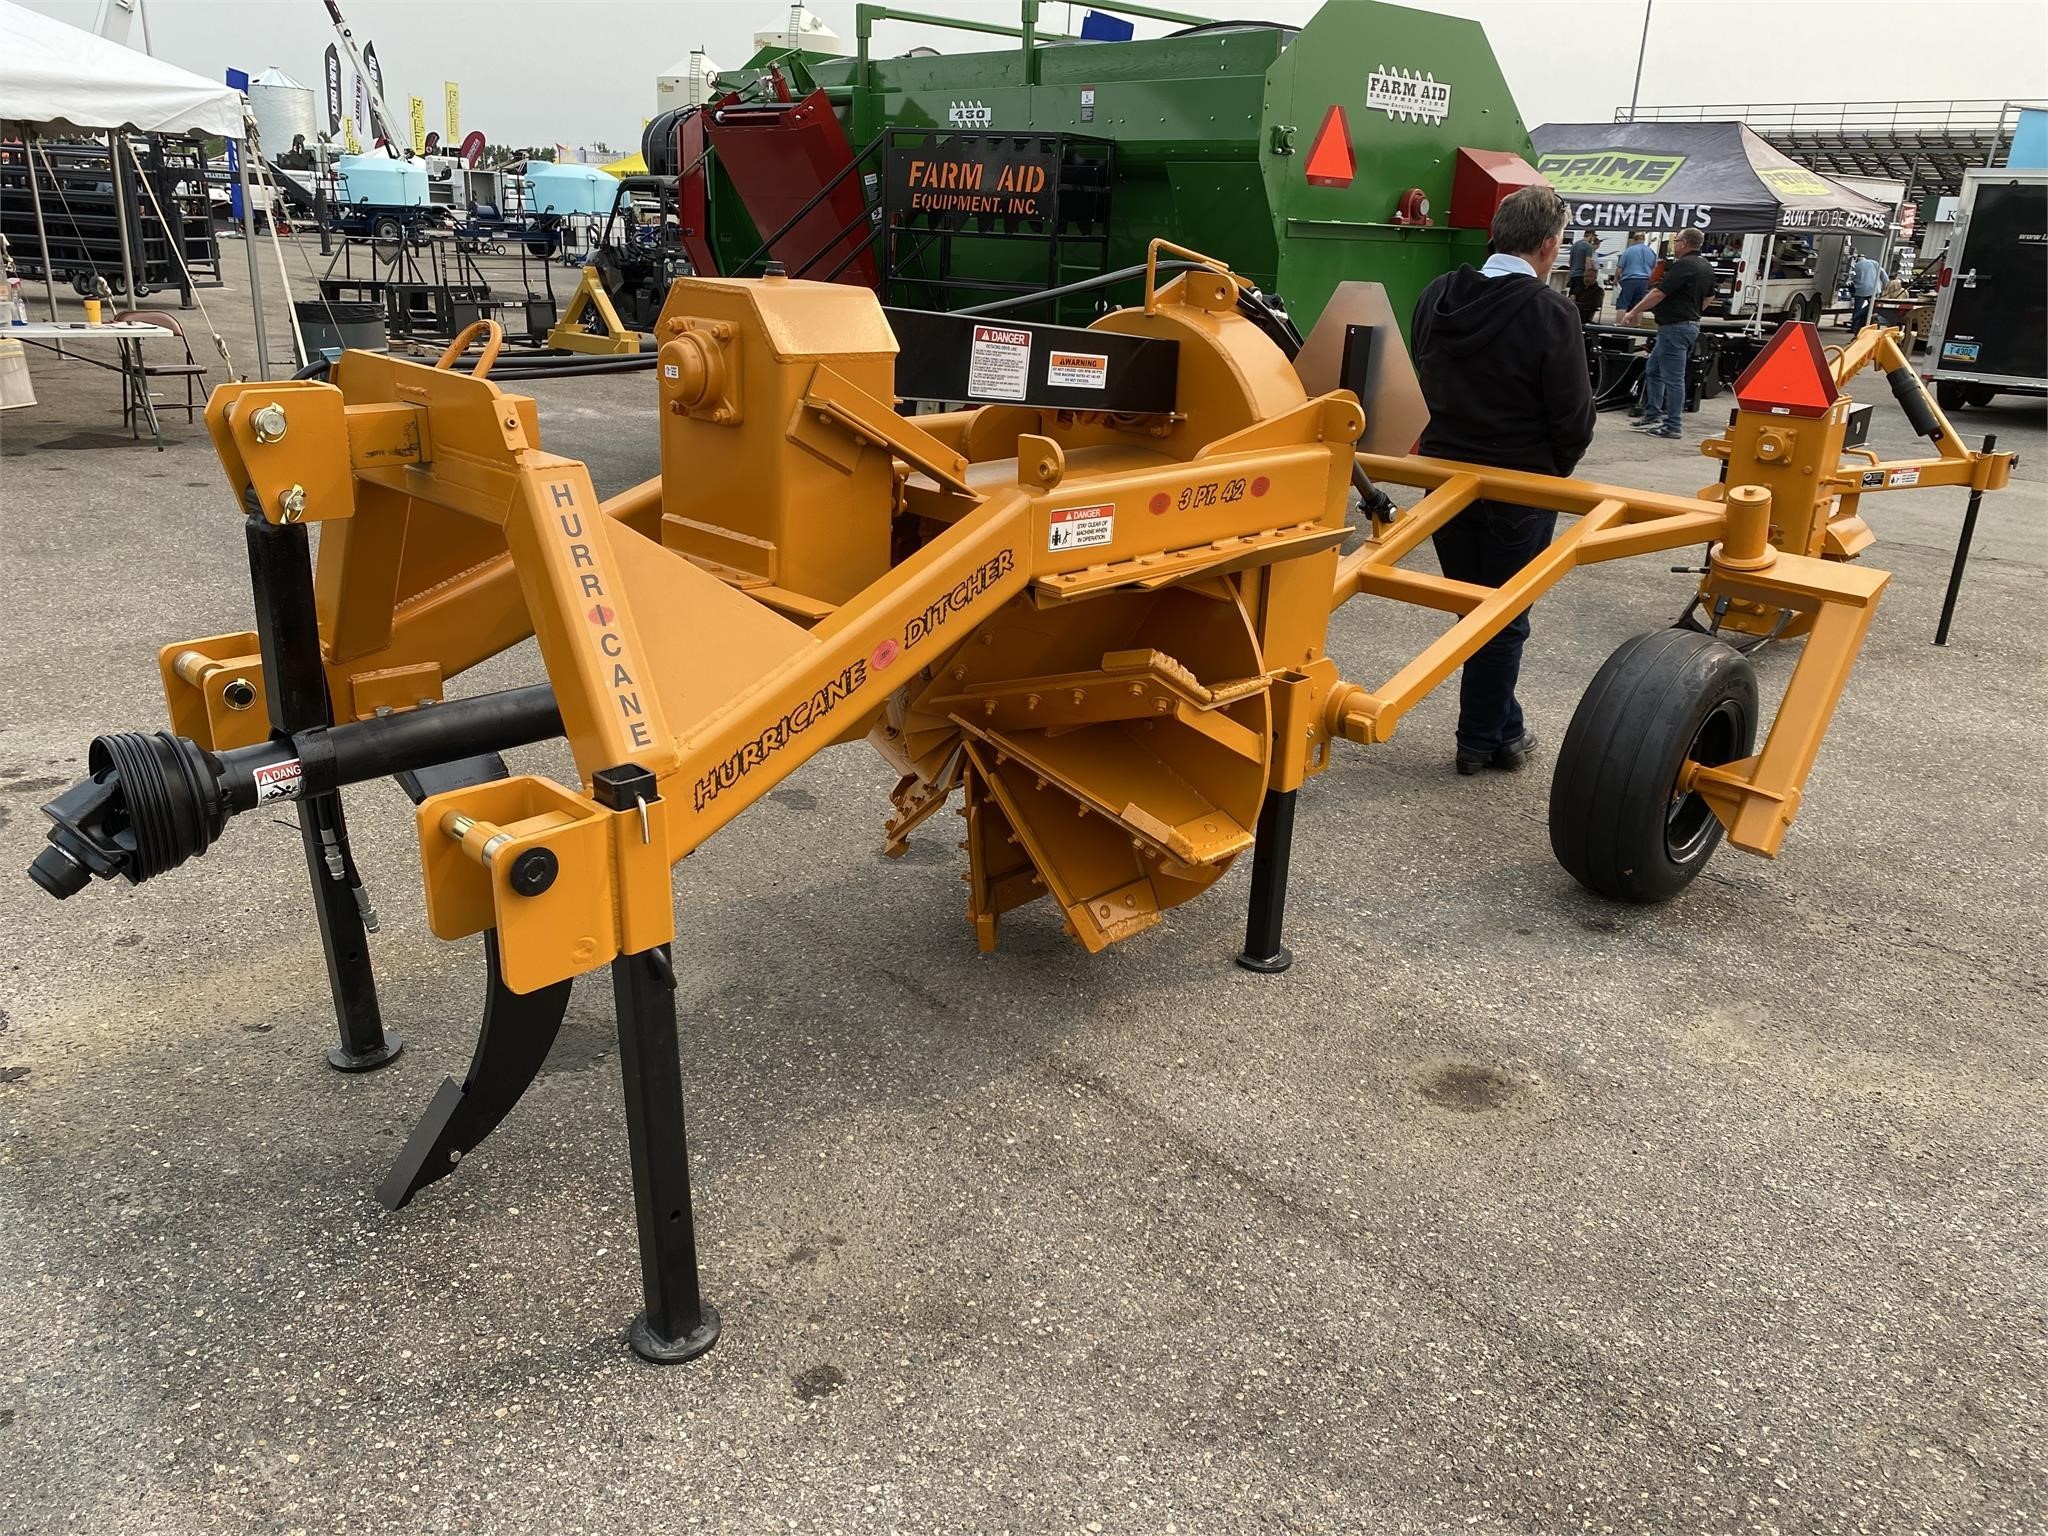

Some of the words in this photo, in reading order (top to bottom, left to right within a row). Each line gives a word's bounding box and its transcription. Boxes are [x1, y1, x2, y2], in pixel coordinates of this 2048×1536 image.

[329, 56, 337, 88] DURA
[1370, 77, 1417, 97] FARM
[1421, 85, 1446, 101] AID
[330, 88, 339, 117] DECK
[955, 109, 985, 120] 430
[908, 160, 984, 190] FARM
[996, 164, 1045, 193] AID
[1538, 156, 1676, 182] PRIME
[1008, 198, 1039, 215] INC.
[1782, 210, 1813, 226] BUILT
[1815, 211, 1829, 227] TO
[1830, 211, 1847, 227] BE
[1846, 211, 1886, 228] BADASS
[992, 331, 1025, 344] DANGER
[1064, 359, 1097, 367] WARNING
[1178, 487, 1193, 511] 3
[1193, 483, 1218, 508] PT.
[1221, 478, 1246, 503] 42
[1073, 509, 1101, 520] DANGER
[1083, 534, 1106, 542] OPERATION
[551, 484, 652, 747] HURRICANE
[693, 658, 867, 812] HURRICANE
[904, 549, 1014, 650] DITCHER
